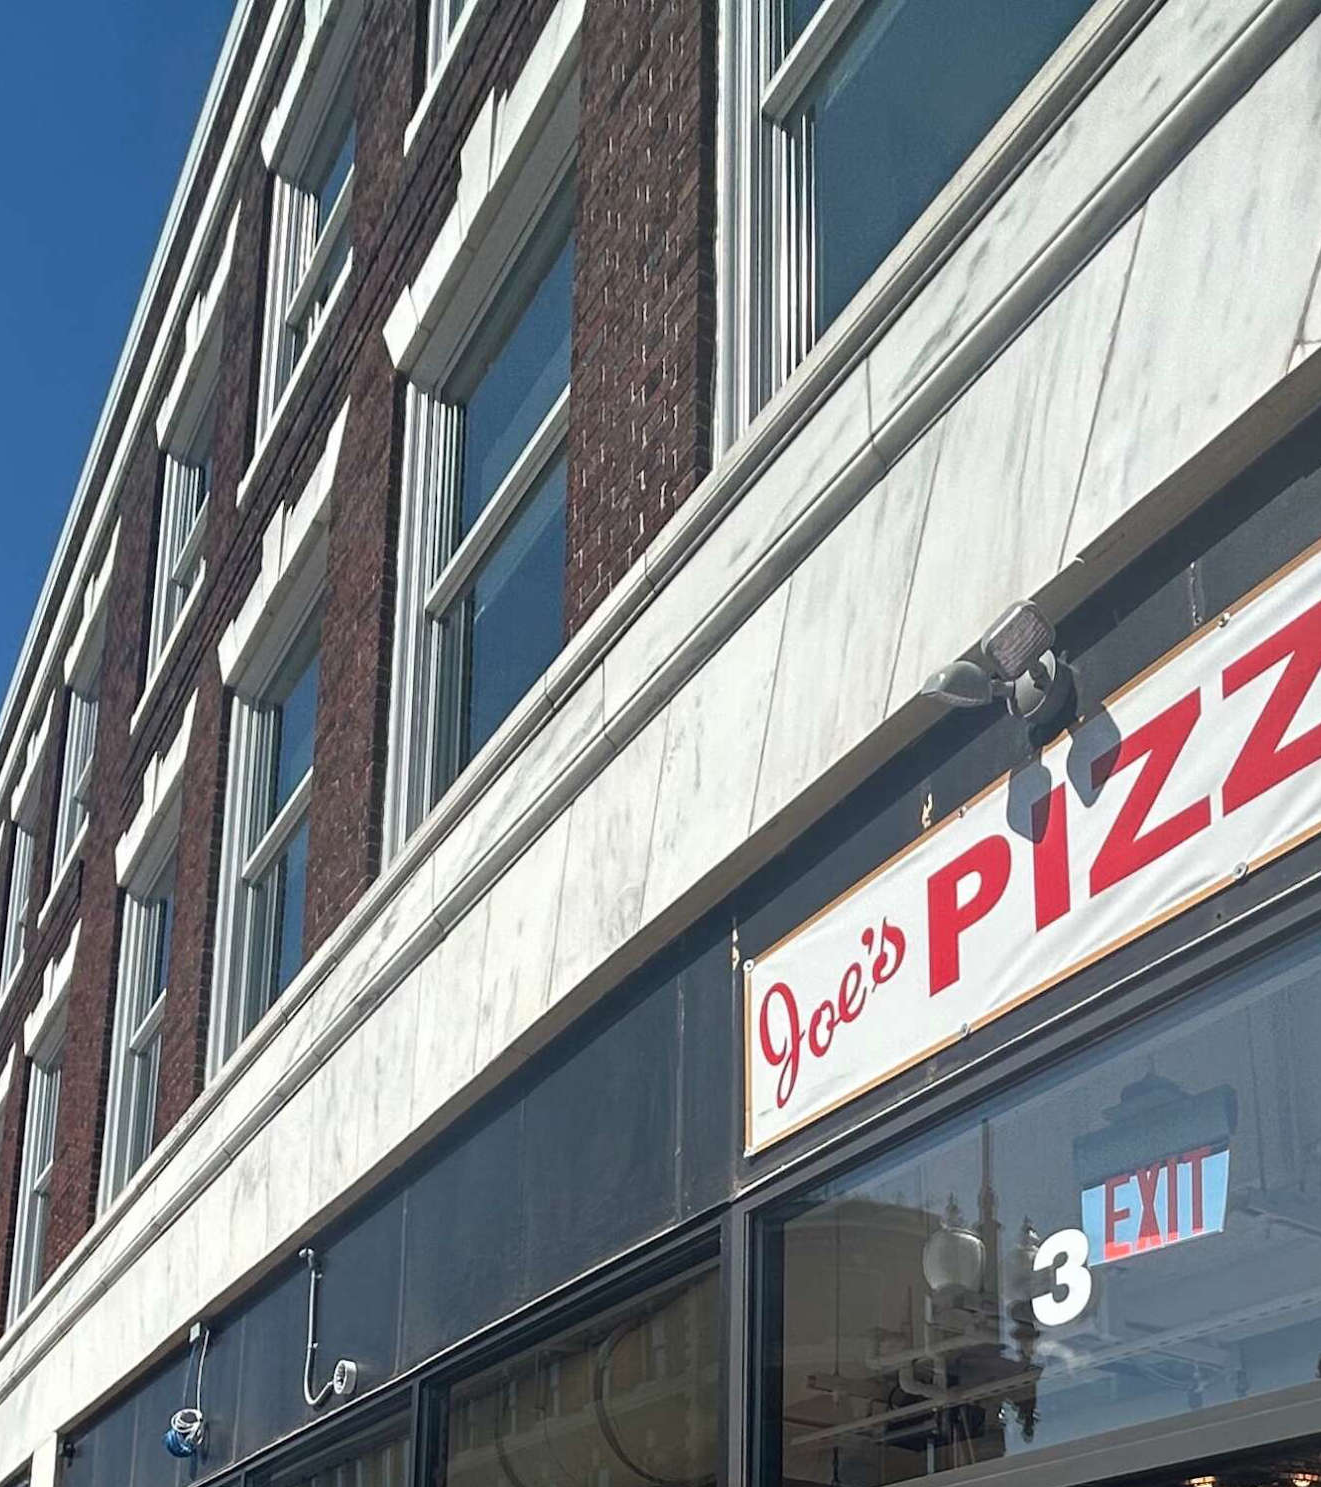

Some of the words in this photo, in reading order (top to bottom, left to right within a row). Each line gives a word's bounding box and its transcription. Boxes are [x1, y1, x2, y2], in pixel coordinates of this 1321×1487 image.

[759, 916, 906, 1108] Joe's
[1103, 1146, 1212, 1260] EXIT
[1032, 1228, 1091, 1326] 3
